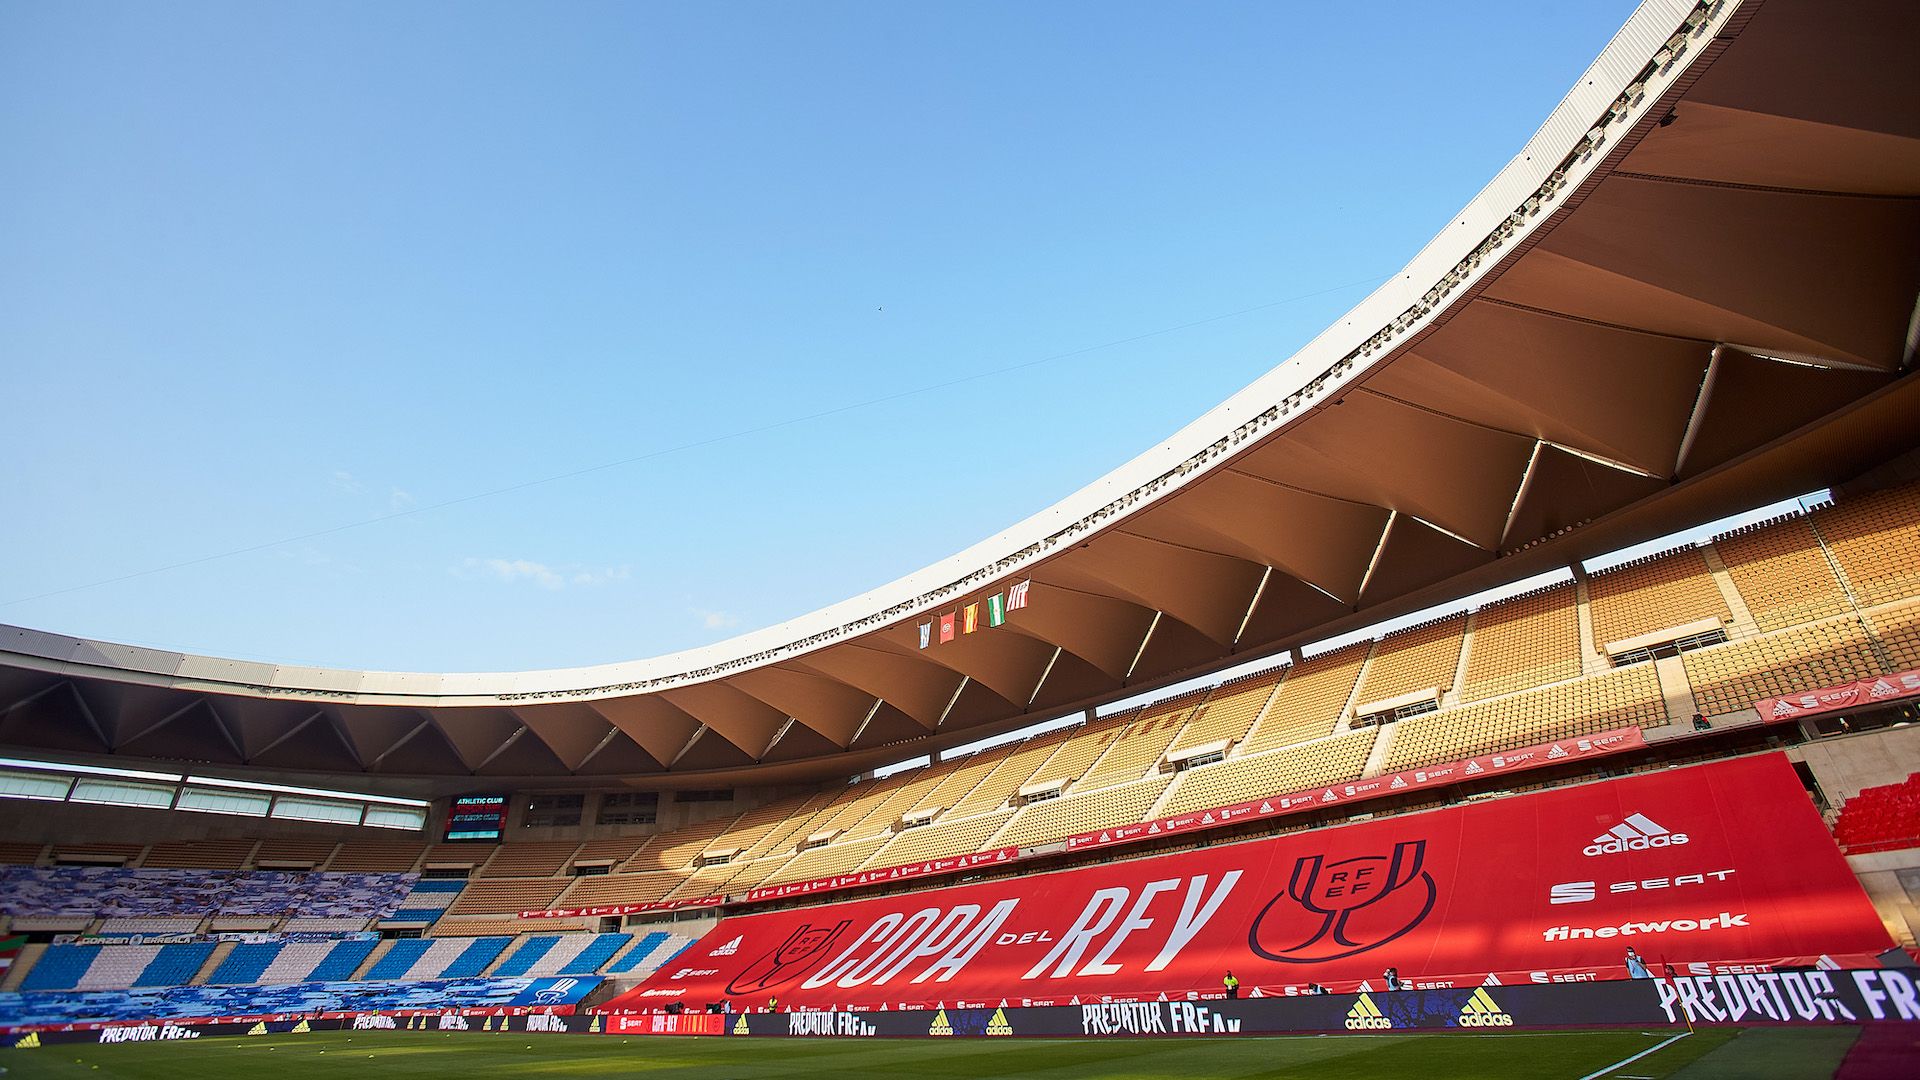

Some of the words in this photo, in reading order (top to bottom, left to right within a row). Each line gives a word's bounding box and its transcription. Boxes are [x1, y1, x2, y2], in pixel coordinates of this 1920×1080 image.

[1820, 688, 1860, 702] SEAT
[1870, 687, 1900, 698] adidas
[1773, 706, 1799, 716] adidas
[1592, 735, 1624, 746] SEAT
[1506, 752, 1535, 763] SEAT
[1428, 768, 1454, 778] SEAT
[1356, 782, 1381, 792] SEAT
[1291, 795, 1313, 804] SEAT
[1231, 807, 1252, 816] SEAT
[1175, 818, 1195, 826] SEAT
[1583, 833, 1690, 857] adidas
[1610, 869, 1736, 894] SEAT
[1021, 870, 1244, 980] REY
[1542, 912, 1750, 942] finetwork
[801, 897, 1020, 989] COPA
[996, 930, 1052, 945] DEL
[1716, 964, 1772, 974] SEAT
[1553, 972, 1597, 983] SEAT
[1417, 981, 1454, 990] SEAT
[1653, 970, 1857, 1024] PREDATOR
[789, 1012, 835, 1035] PREDATOR
[1082, 1002, 1167, 1035] PREDATOR
[1344, 1016, 1392, 1030] adidas
[1458, 1012, 1514, 1028] adidas
[99, 1026, 159, 1043] PREDATOR
[929, 1025, 954, 1036] adidas
[985, 1025, 1013, 1036] adidas
